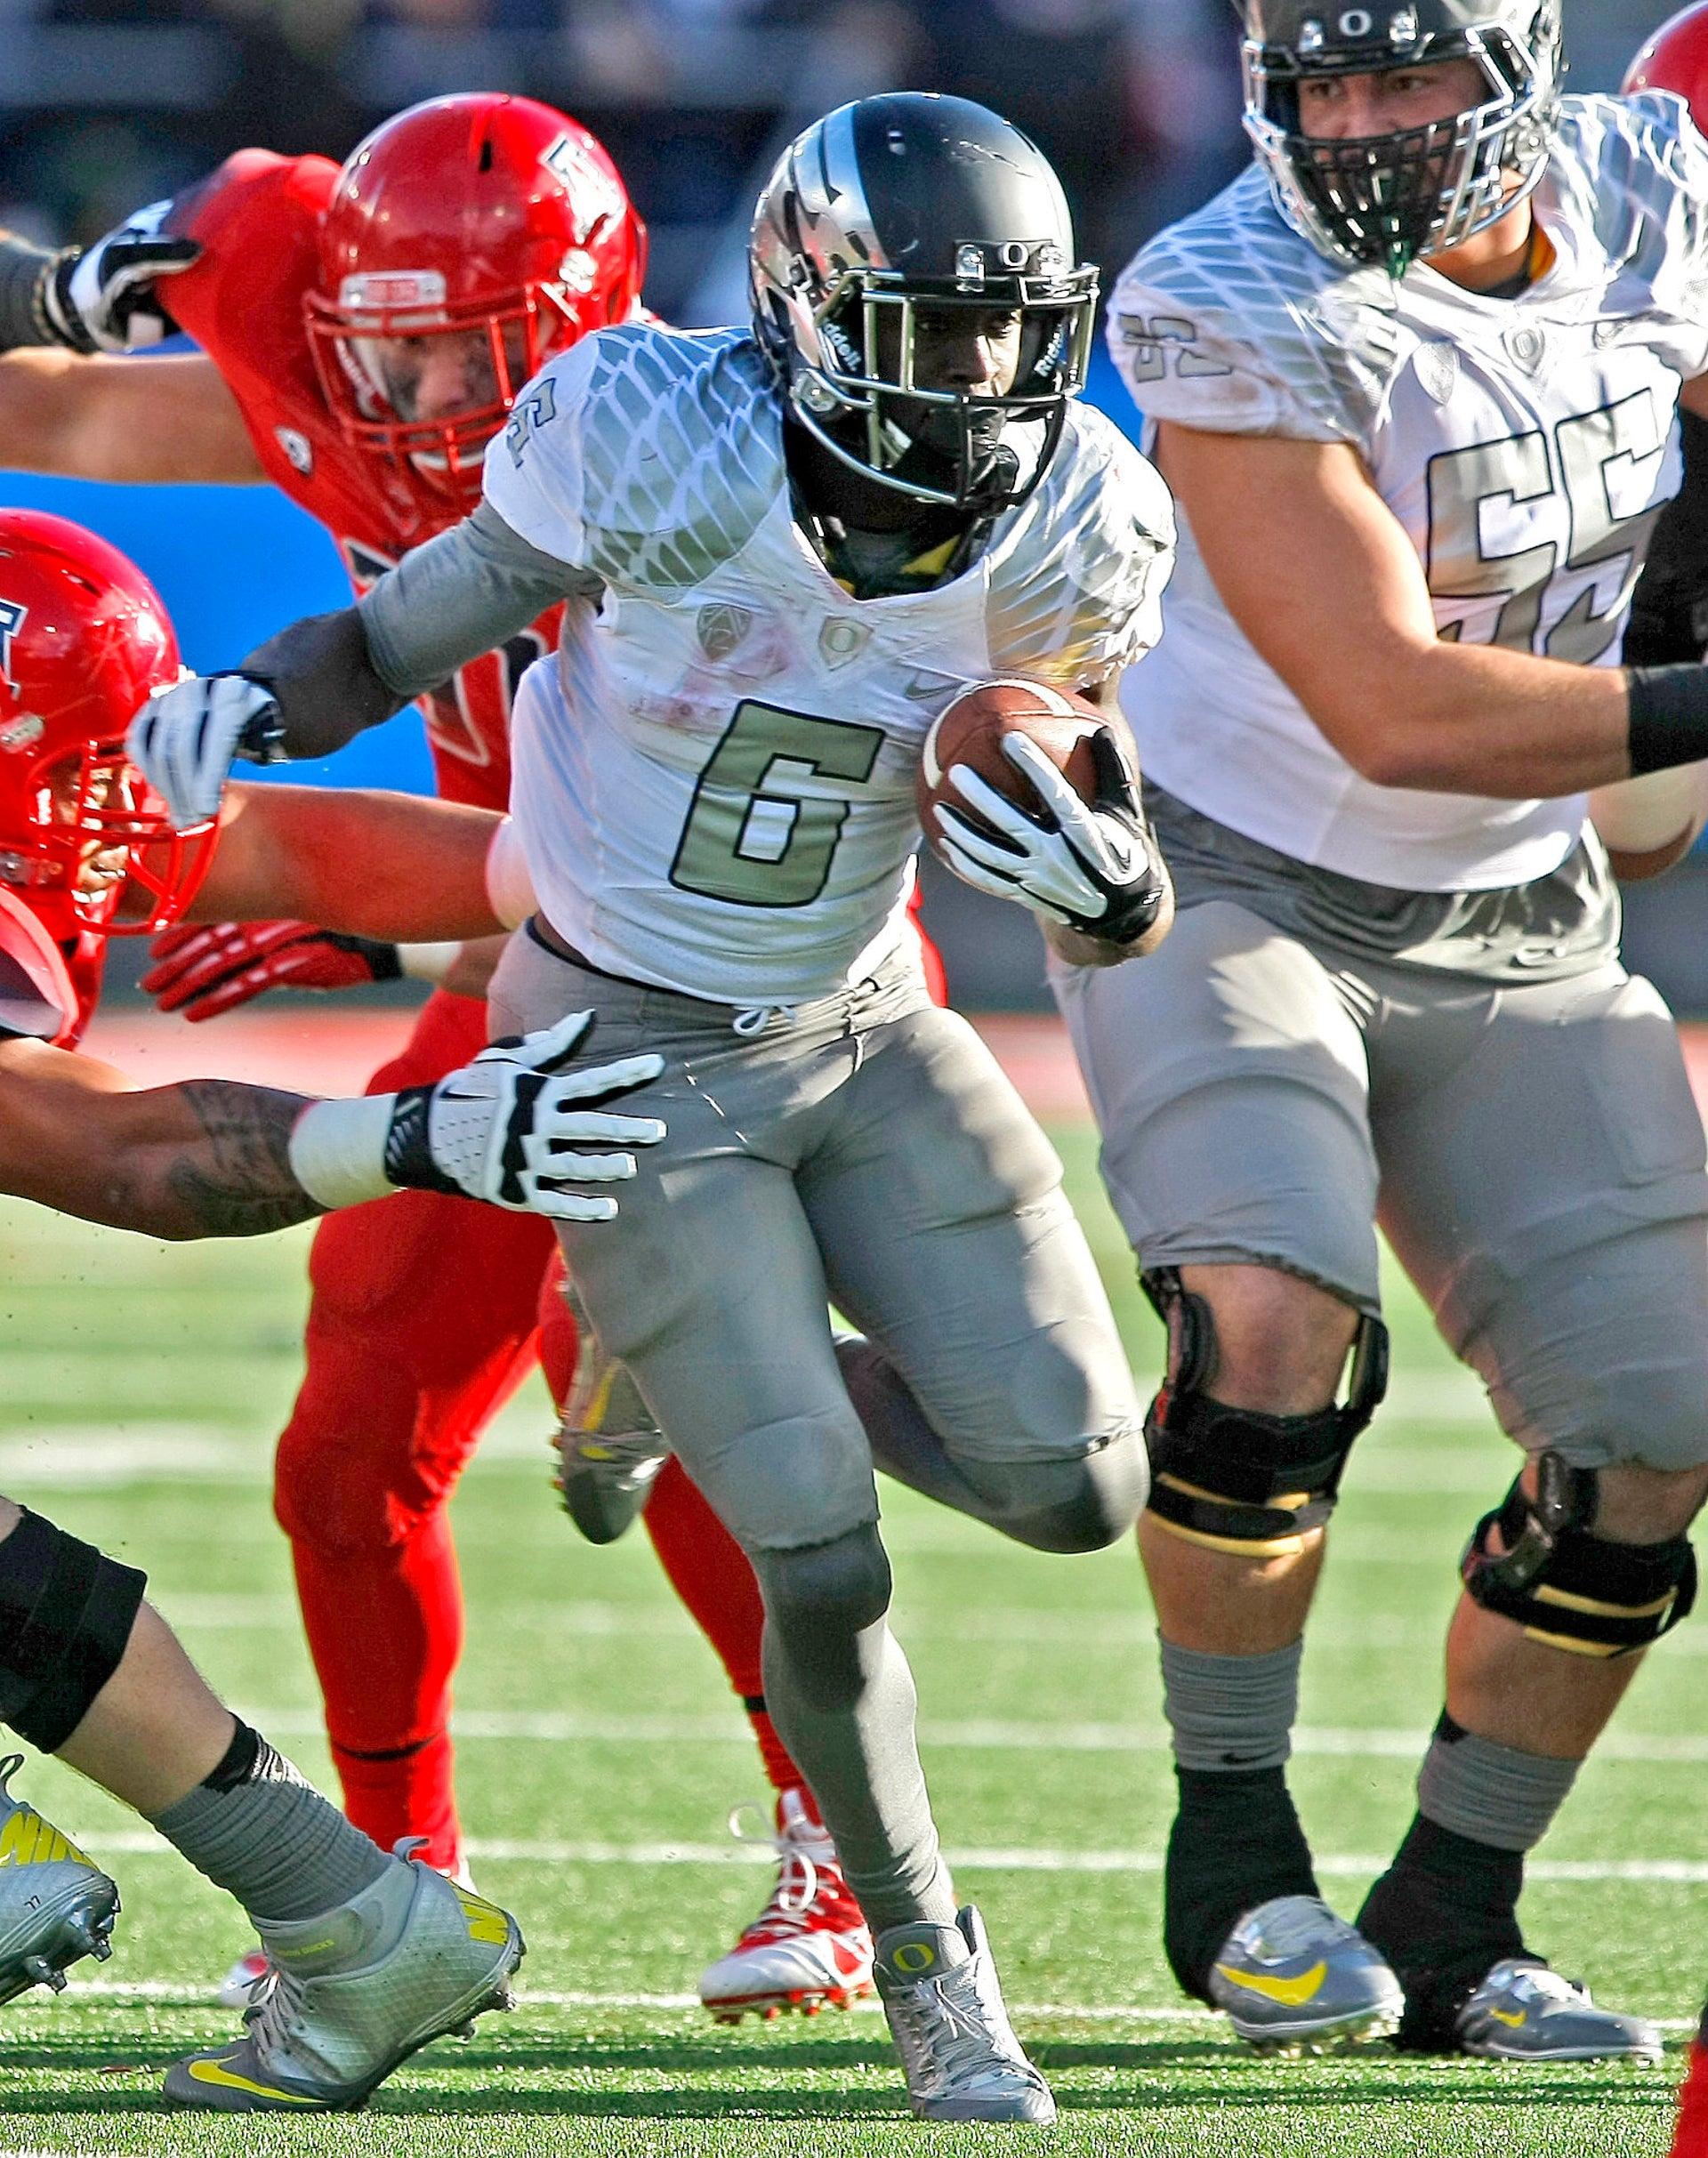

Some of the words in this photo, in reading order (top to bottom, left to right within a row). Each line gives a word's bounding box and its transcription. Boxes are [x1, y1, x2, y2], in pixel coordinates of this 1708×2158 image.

[1339, 9, 1371, 36] O
[999, 242, 1029, 268] O
[668, 698, 886, 908] 6
[894, 1944, 934, 1971] O
